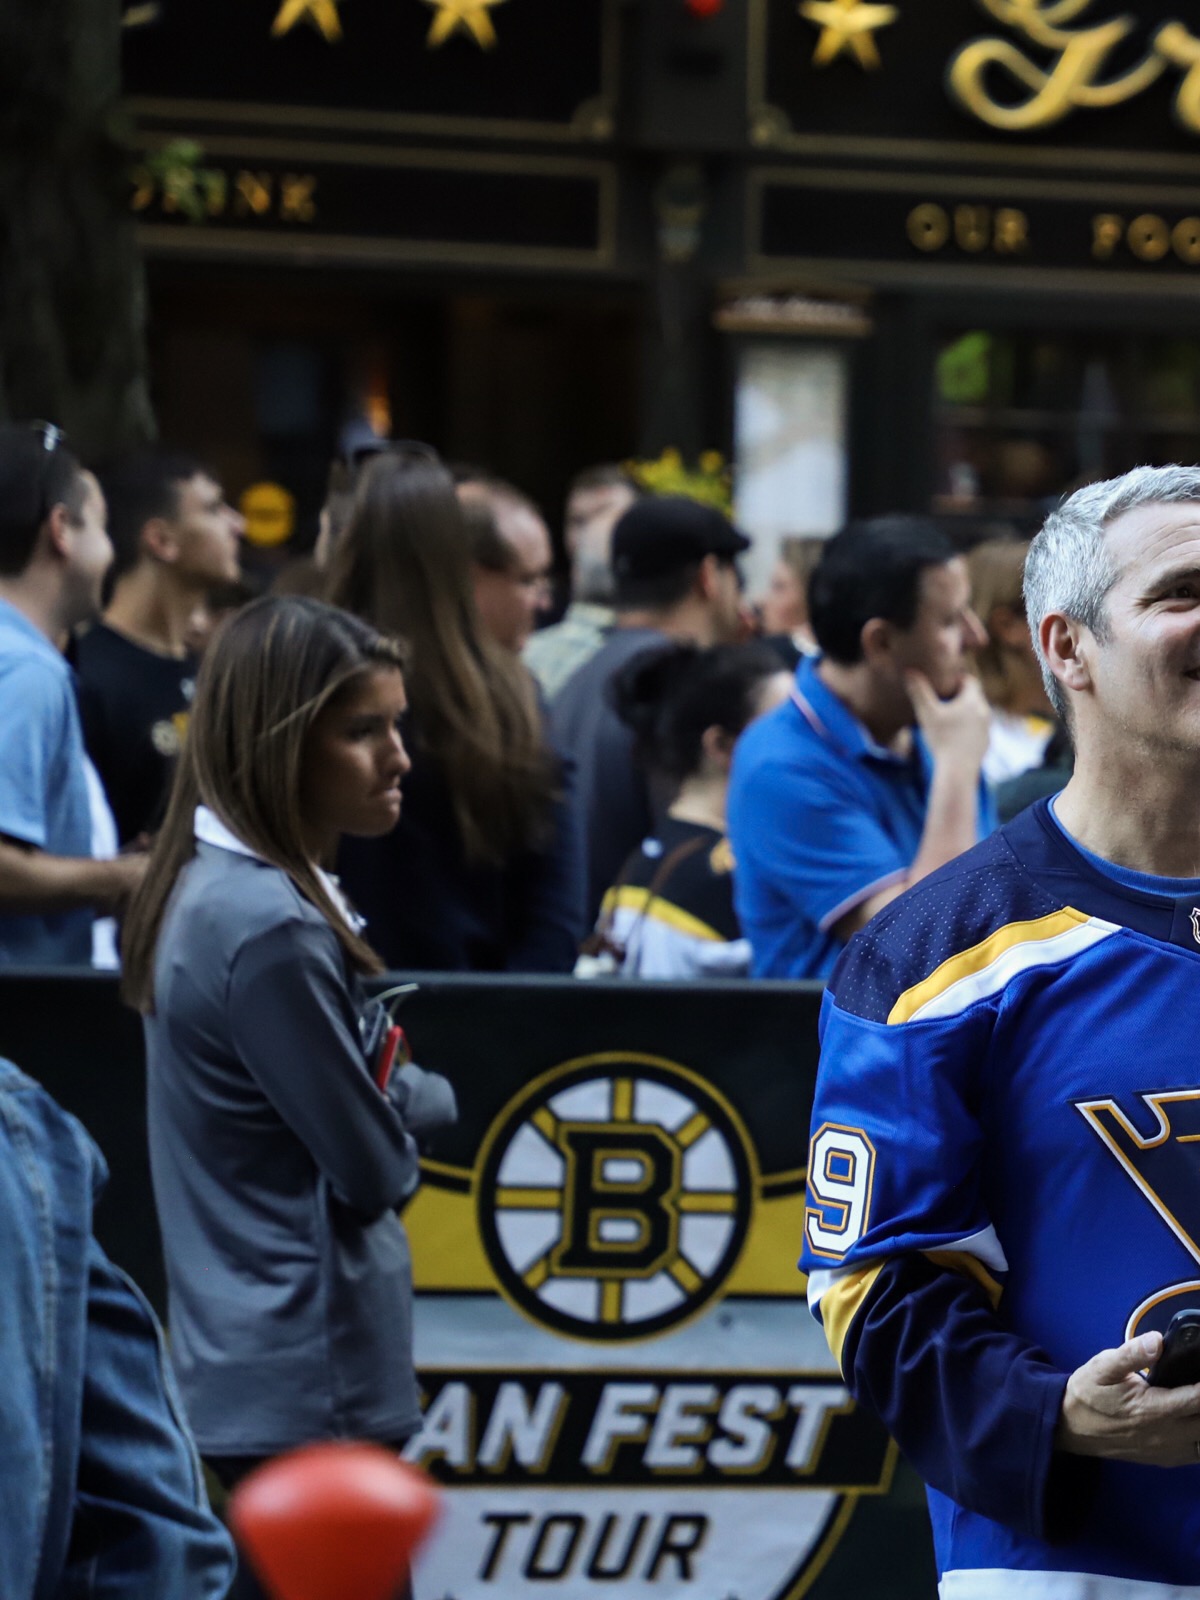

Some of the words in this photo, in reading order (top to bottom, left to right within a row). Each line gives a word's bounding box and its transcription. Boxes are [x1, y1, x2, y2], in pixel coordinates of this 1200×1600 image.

[905, 202, 1030, 255] OUR
[804, 1121, 877, 1261] 9
[401, 1381, 571, 1474] AN
[579, 1381, 857, 1475] FEST
[476, 1511, 712, 1582] TOUR
